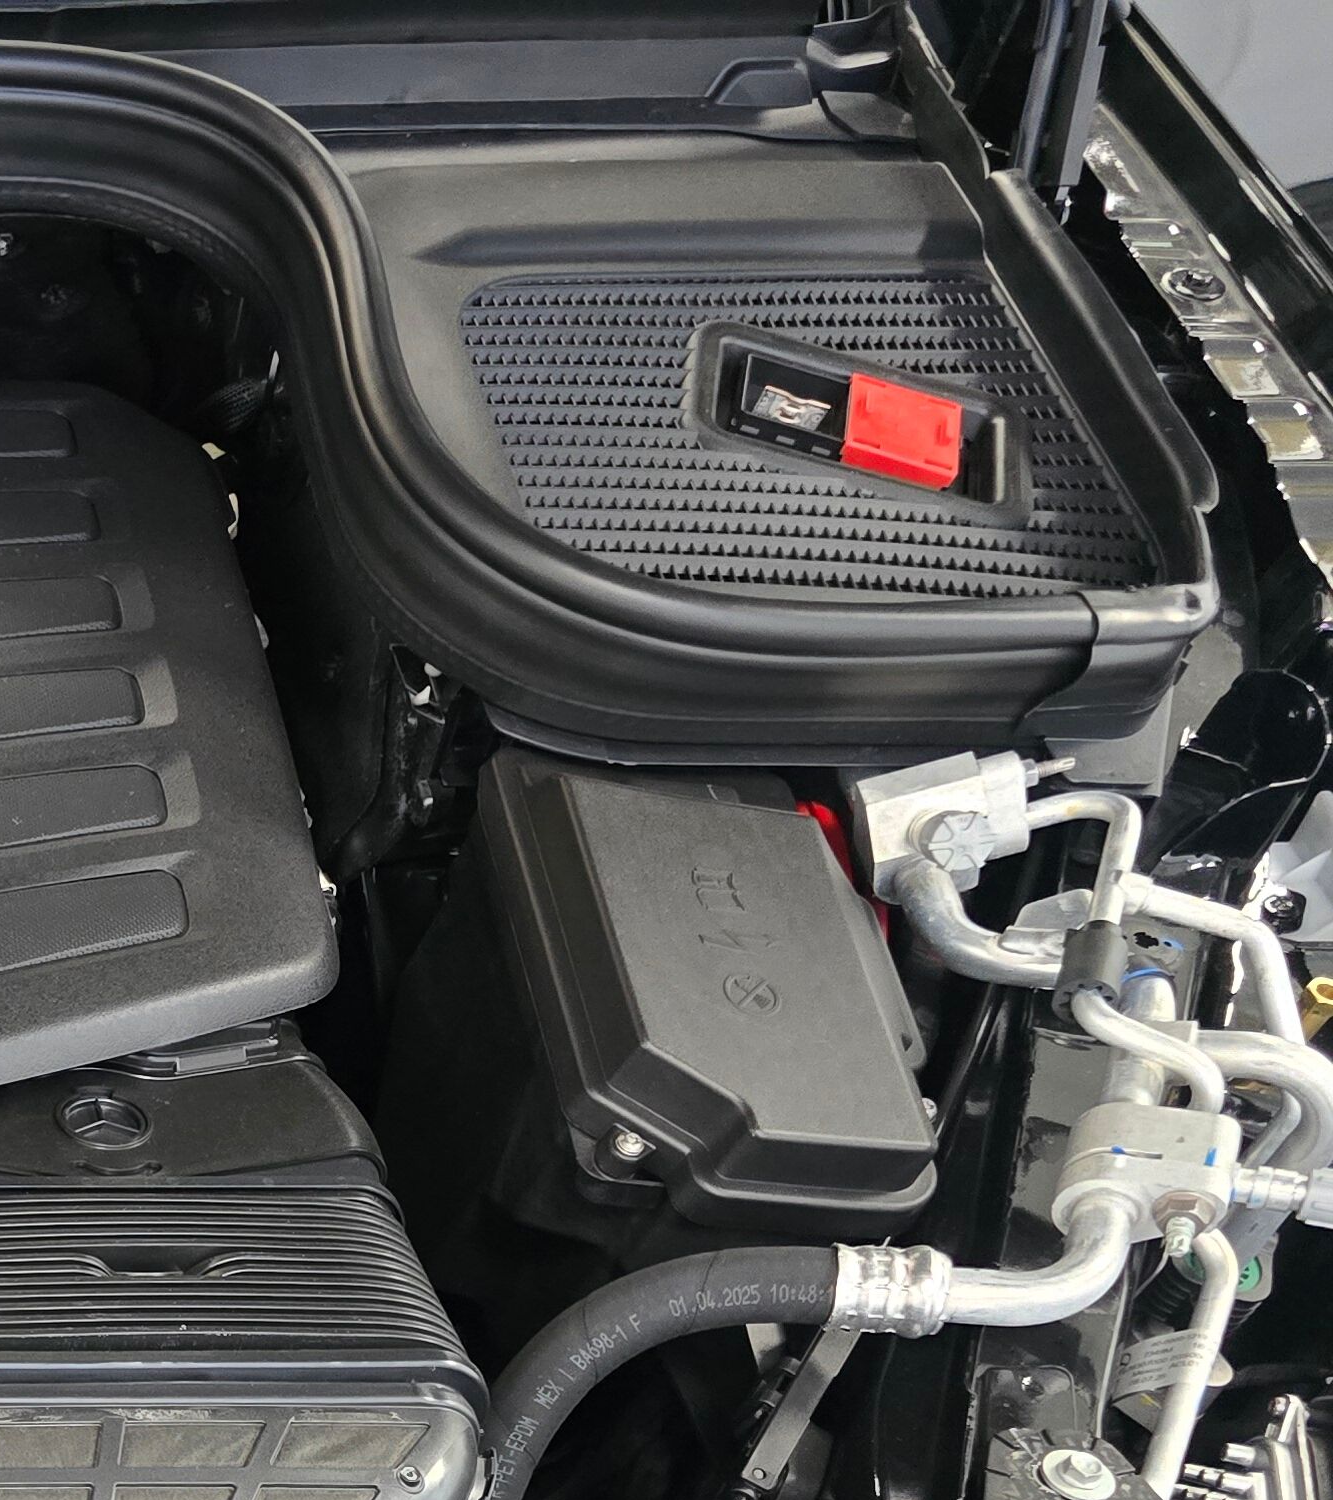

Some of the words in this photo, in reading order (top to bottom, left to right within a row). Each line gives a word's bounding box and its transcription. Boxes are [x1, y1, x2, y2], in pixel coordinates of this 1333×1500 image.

[569, 1324, 629, 1371] BA698-1
[628, 1313, 641, 1333] F
[668, 1284, 762, 1318] 01.04.2025
